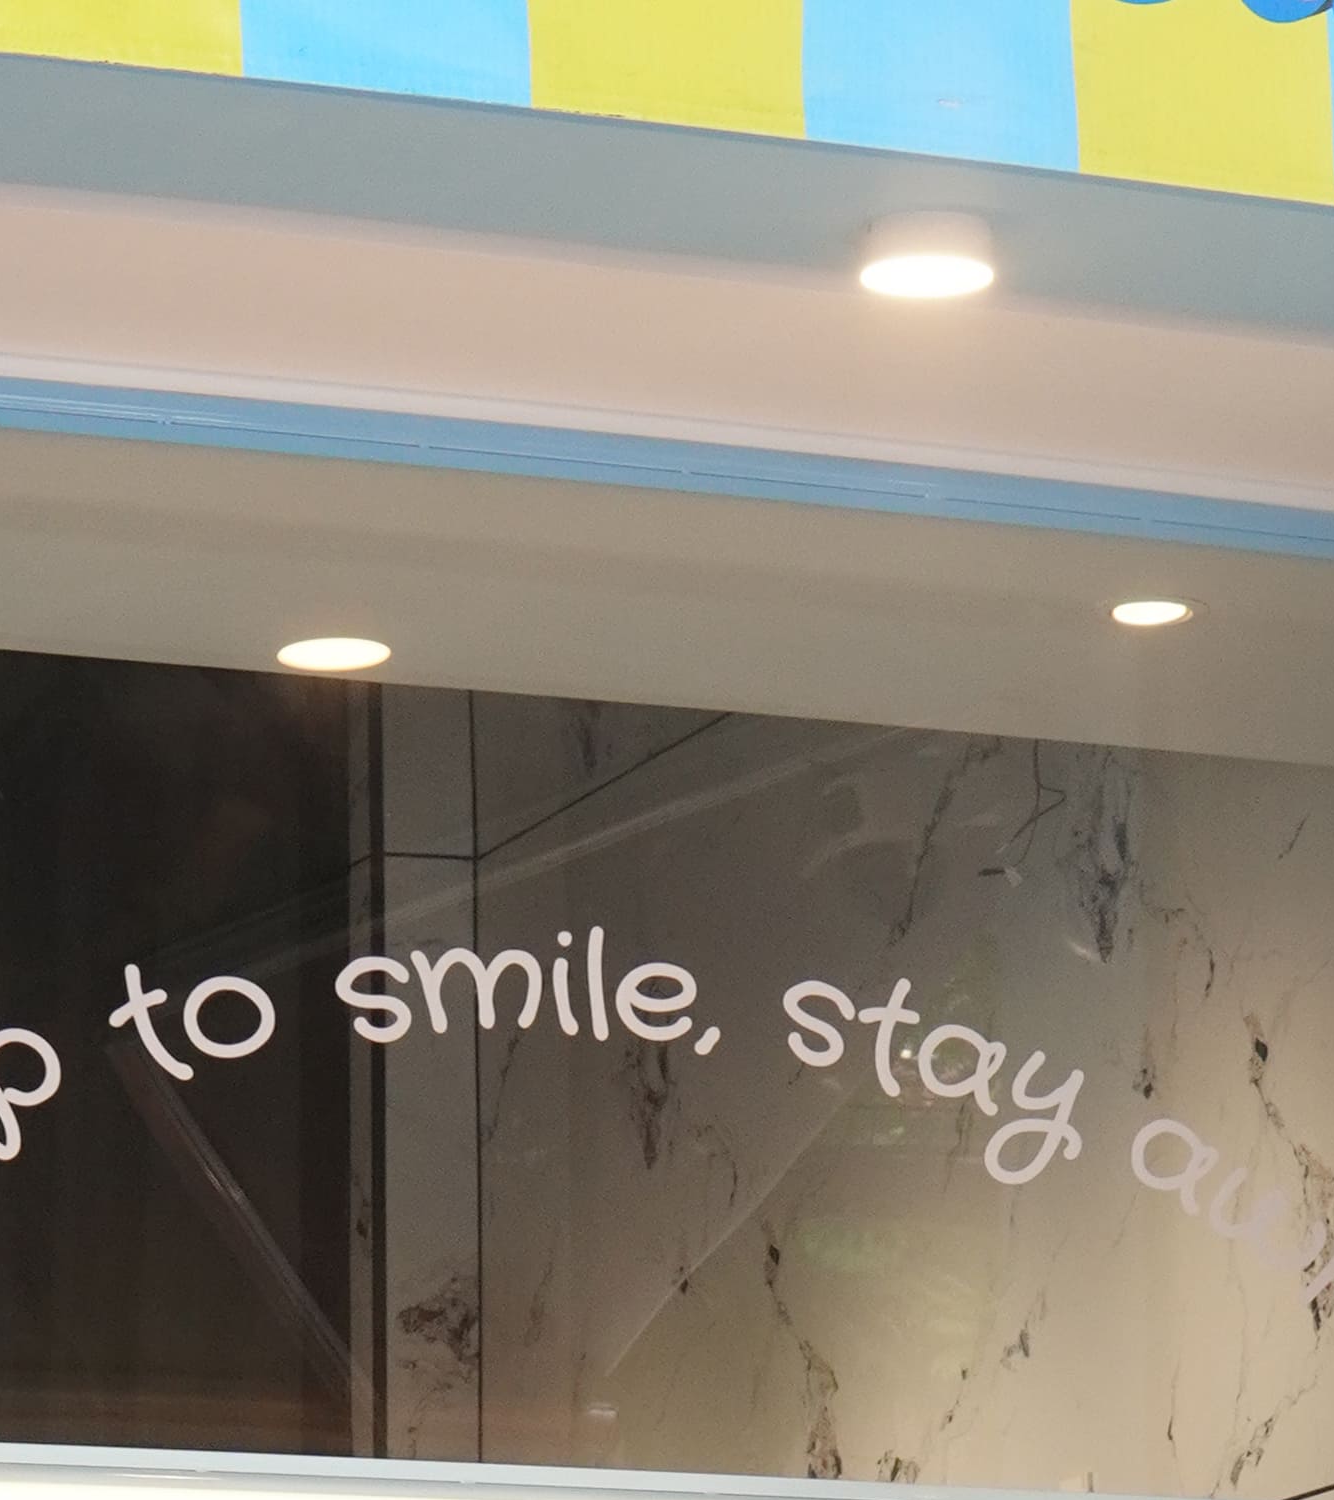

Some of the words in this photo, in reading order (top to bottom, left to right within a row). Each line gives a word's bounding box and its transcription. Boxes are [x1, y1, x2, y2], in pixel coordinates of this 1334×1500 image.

[109, 964, 276, 1081] to
[335, 926, 721, 1055] smile,
[782, 977, 1085, 1184] stay
